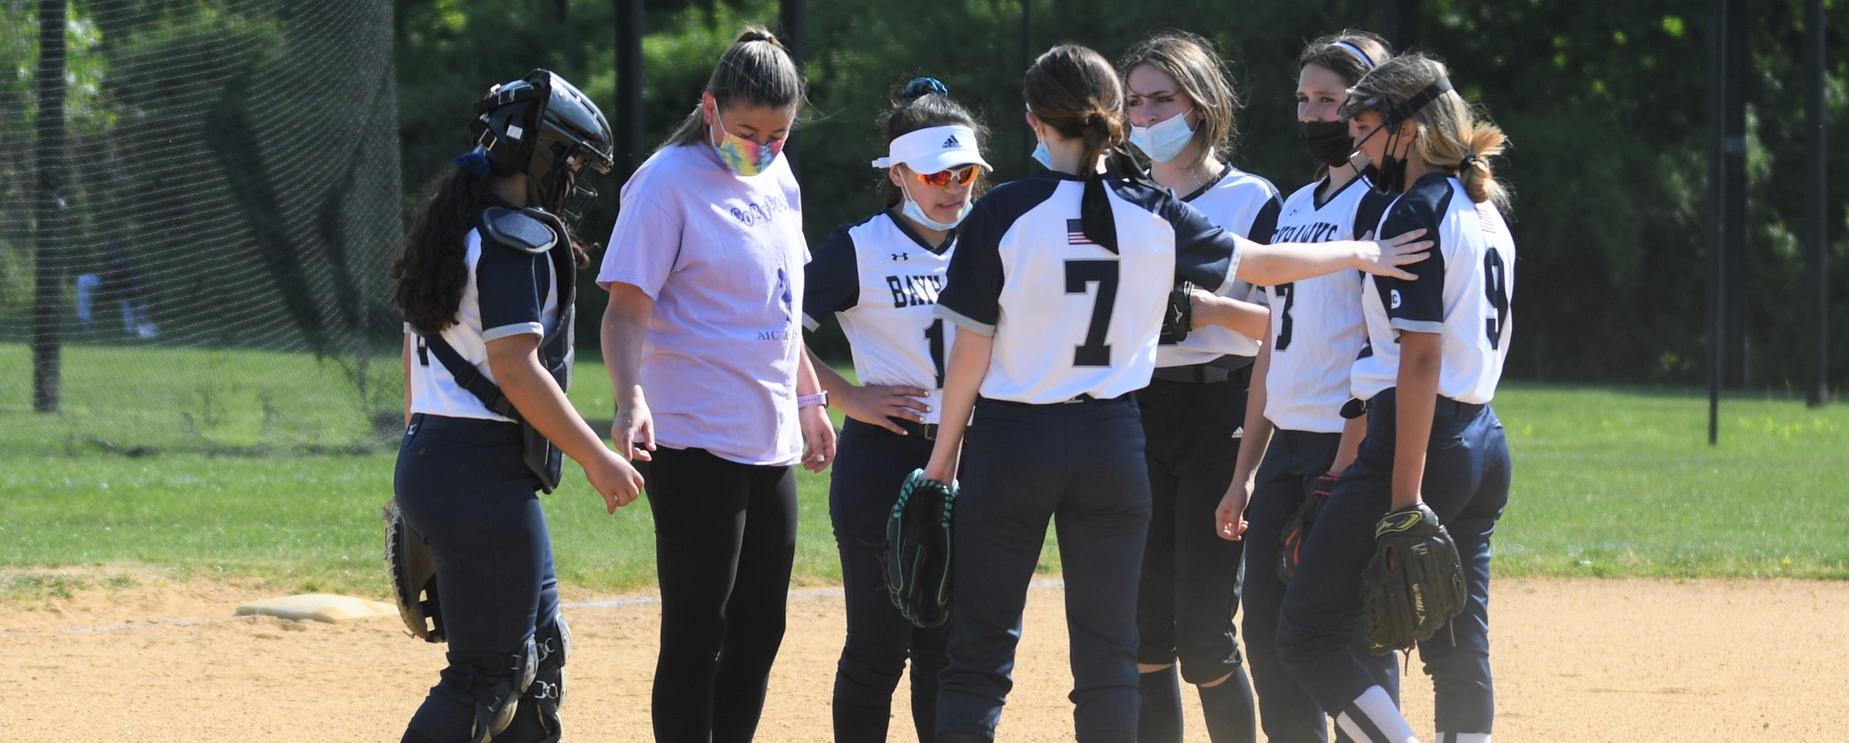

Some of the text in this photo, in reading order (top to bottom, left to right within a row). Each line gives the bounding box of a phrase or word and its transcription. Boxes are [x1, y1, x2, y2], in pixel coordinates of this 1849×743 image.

[1064, 260, 1119, 366] 7
[1484, 247, 1508, 350] 9
[924, 318, 945, 389] 1
